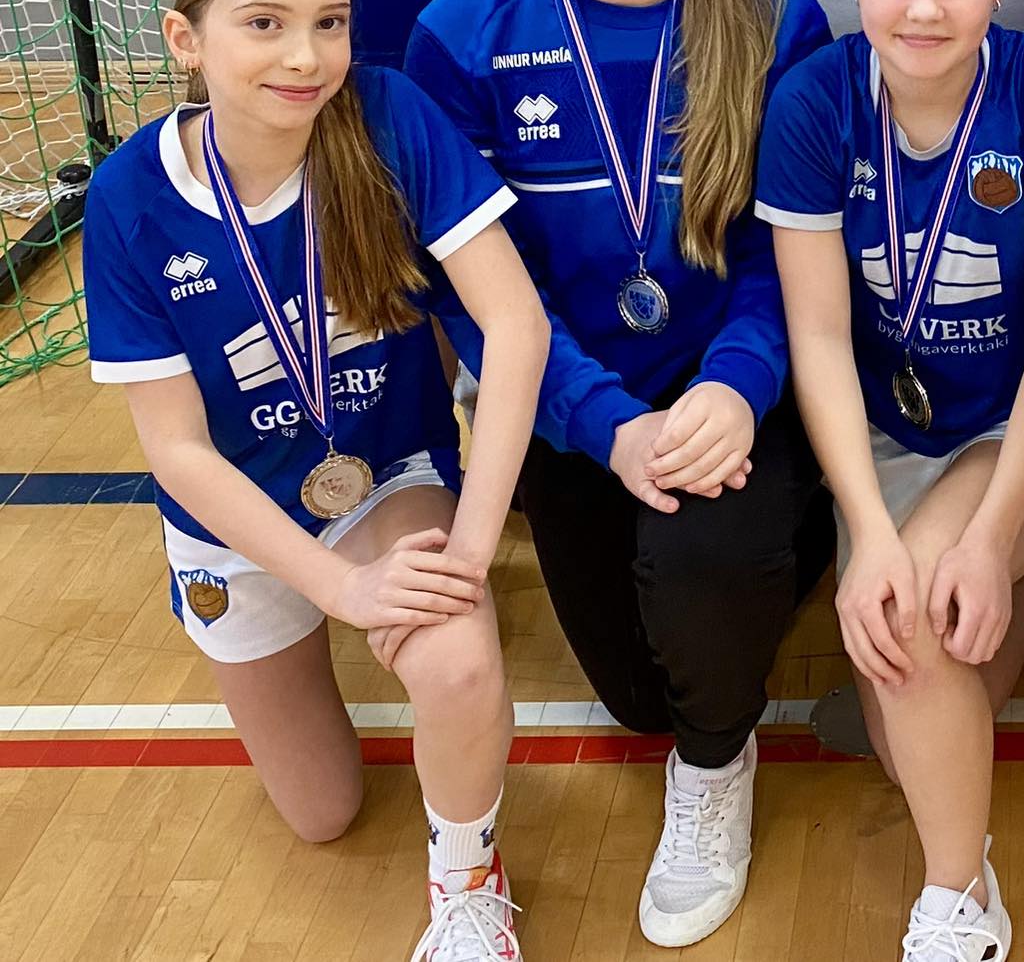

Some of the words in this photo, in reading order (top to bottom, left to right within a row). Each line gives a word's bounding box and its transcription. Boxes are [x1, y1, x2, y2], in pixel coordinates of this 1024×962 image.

[492, 52, 530, 70] UNNUR
[532, 47, 572, 64] MARÍA
[518, 123, 560, 141] errea
[170, 277, 217, 301] errea
[919, 314, 1008, 340] VERK
[250, 400, 301, 430] GG
[329, 363, 388, 396] ERK
